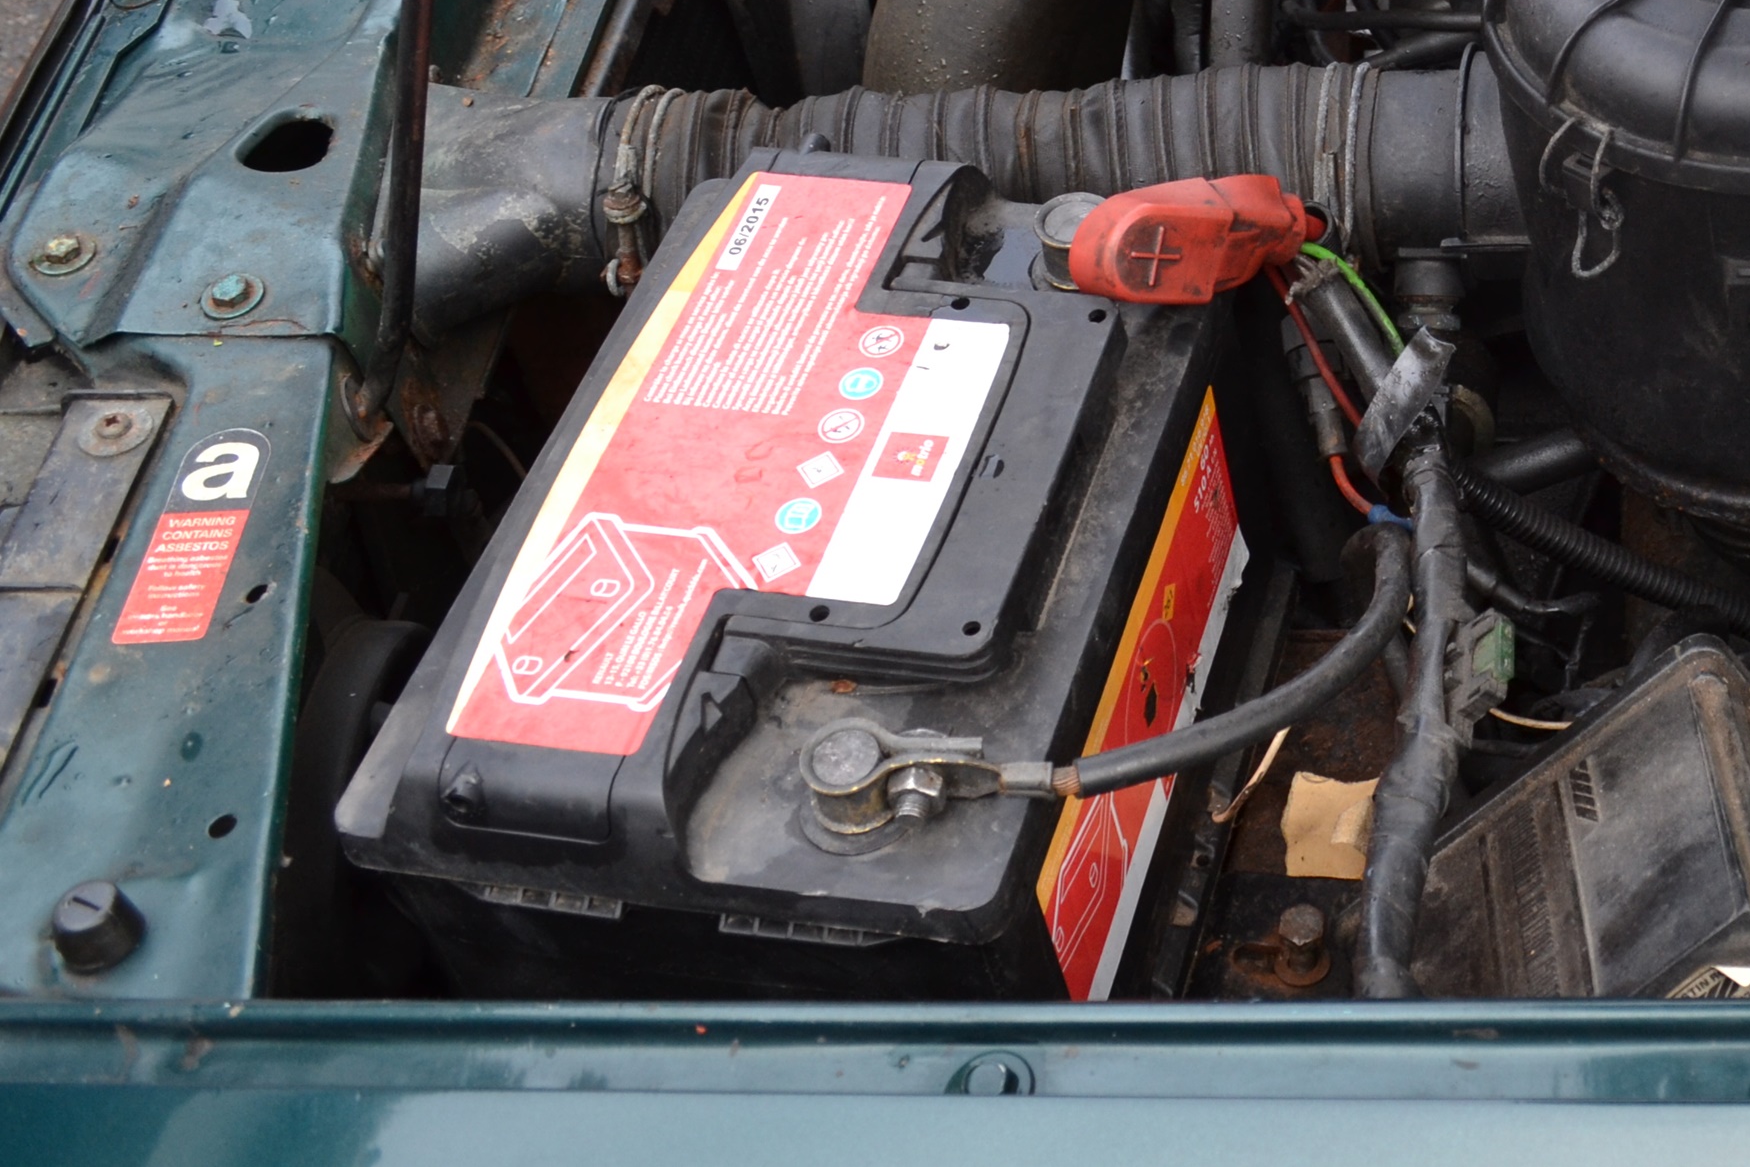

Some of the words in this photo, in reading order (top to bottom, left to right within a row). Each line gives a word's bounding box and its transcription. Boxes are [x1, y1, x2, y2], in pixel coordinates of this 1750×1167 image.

[728, 196, 770, 256] 06/2015
[910, 439, 935, 477] motrio
[181, 441, 260, 501] a
[162, 528, 233, 540] CONTAINS
[169, 516, 236, 527] WARNING
[154, 541, 229, 553] ASBESTOS
